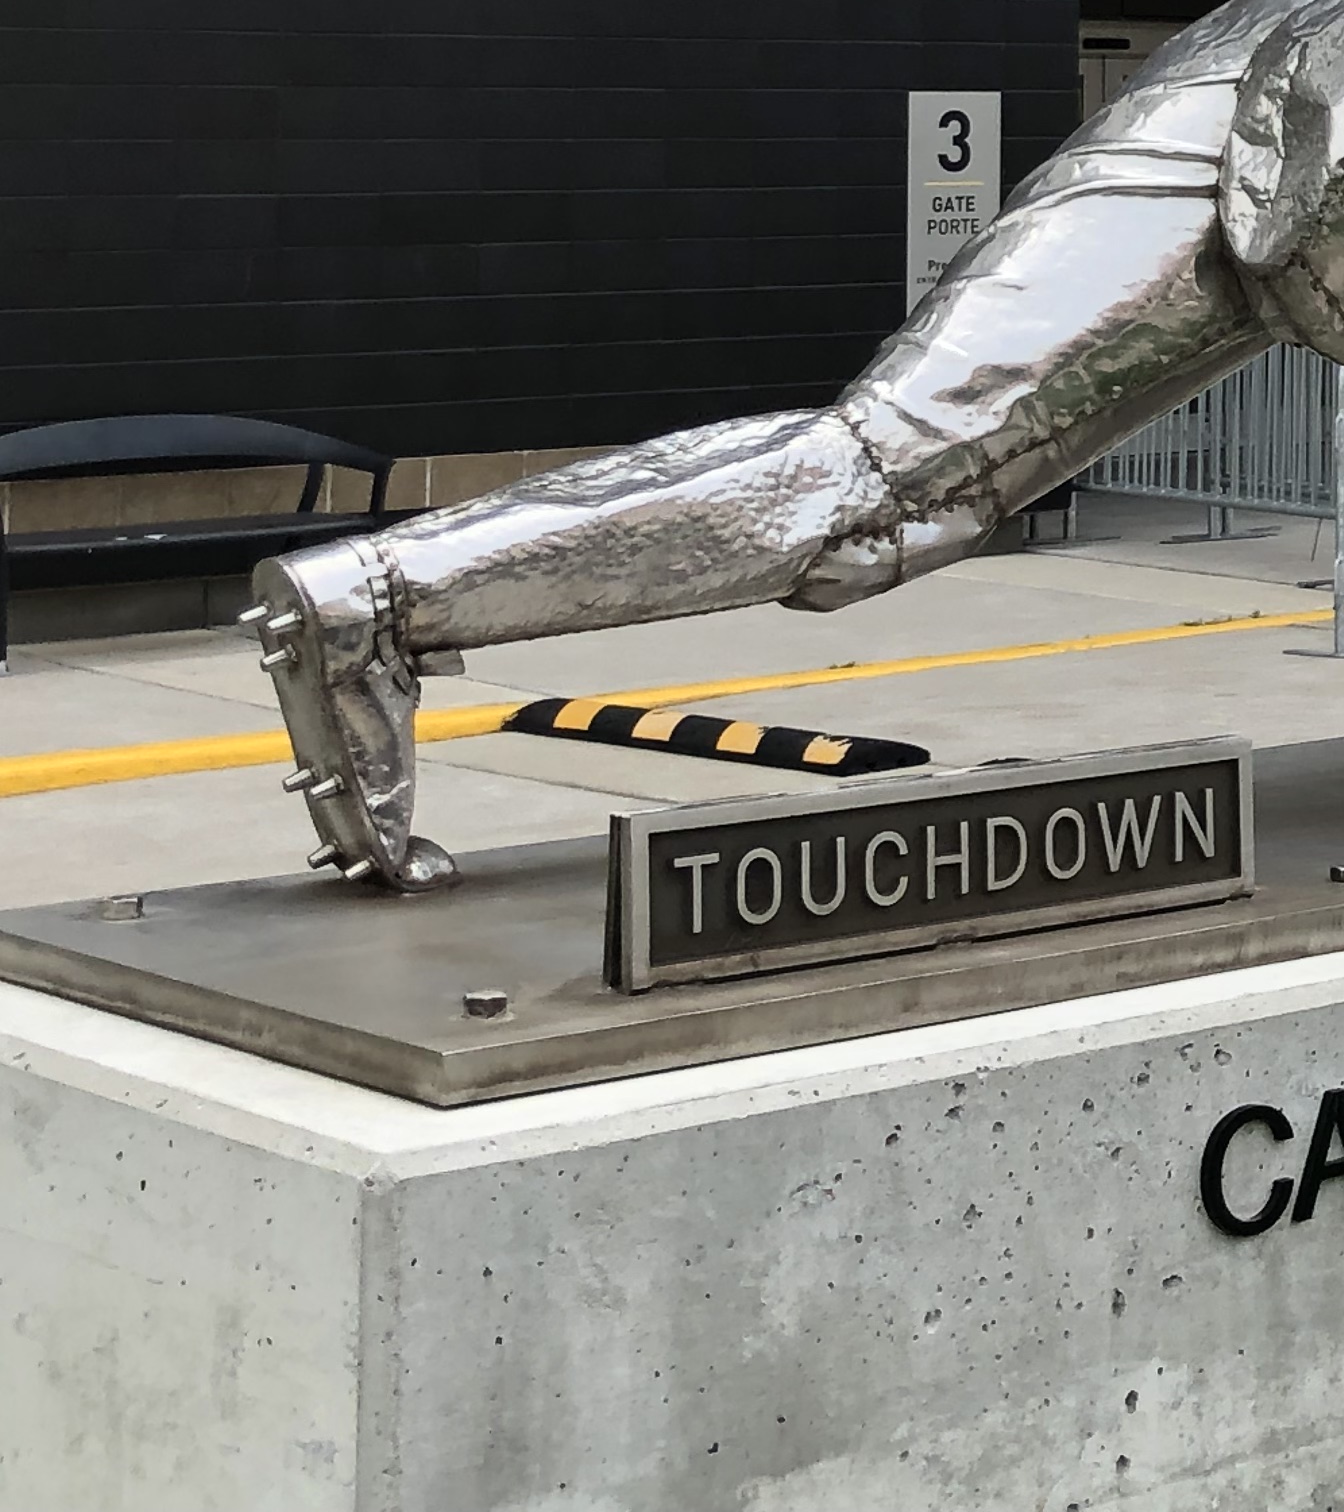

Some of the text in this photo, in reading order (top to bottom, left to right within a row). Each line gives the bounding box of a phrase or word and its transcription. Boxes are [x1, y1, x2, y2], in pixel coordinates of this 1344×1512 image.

[937, 109, 972, 173] 3
[931, 195, 977, 214] GATE
[926, 217, 981, 236] PORTE
[672, 787, 1216, 935] TOUCHDOWN
